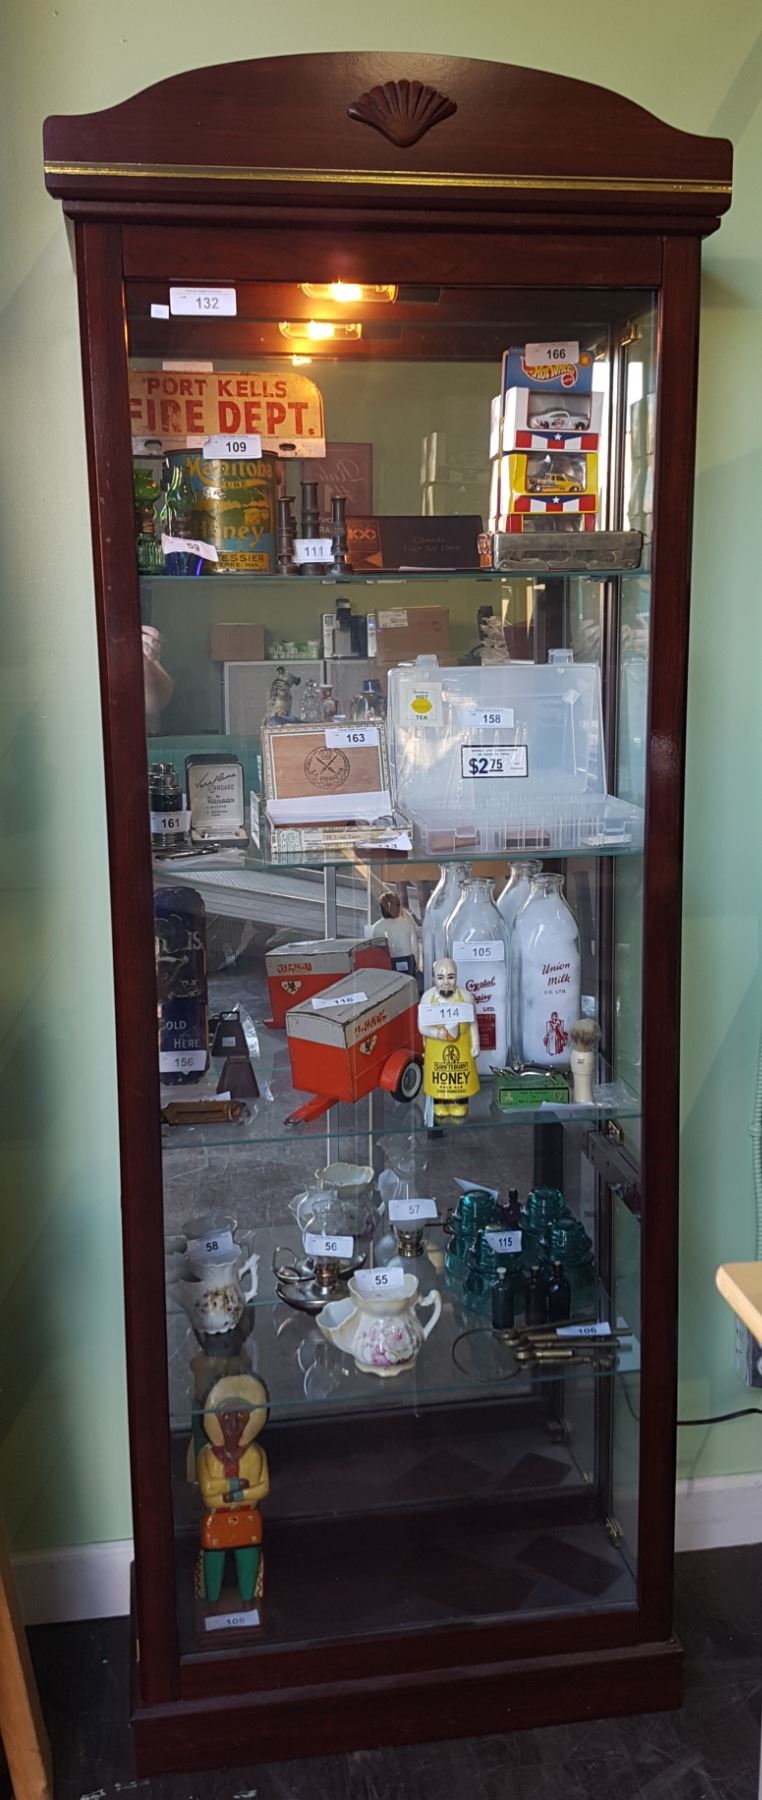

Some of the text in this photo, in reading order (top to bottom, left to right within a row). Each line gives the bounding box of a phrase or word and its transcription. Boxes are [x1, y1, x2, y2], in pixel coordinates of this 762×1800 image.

[195, 297, 220, 310] 132
[546, 348, 567, 360] 166
[147, 378, 288, 399] PORT KELLS
[217, 400, 316, 436] DEPT.
[225, 441, 247, 453] 109
[304, 546, 324, 557] 111
[221, 553, 265, 563] ESSIER
[483, 714, 501, 724] 158
[346, 733, 366, 743] 163
[161, 817, 181, 829] 161
[472, 947, 491, 957] 105
[541, 961, 570, 975] Union
[548, 973, 570, 986] Milk
[439, 1007, 460, 1019] 114
[173, 1038, 201, 1050] HERE
[174, 1057, 194, 1068] 156
[432, 1071, 471, 1085] HONEY
[408, 1205, 420, 1214] 57
[206, 1241, 219, 1252] 58
[325, 1241, 337, 1251] 56
[498, 1236, 513, 1247] 115
[375, 1275, 388, 1285] 55
